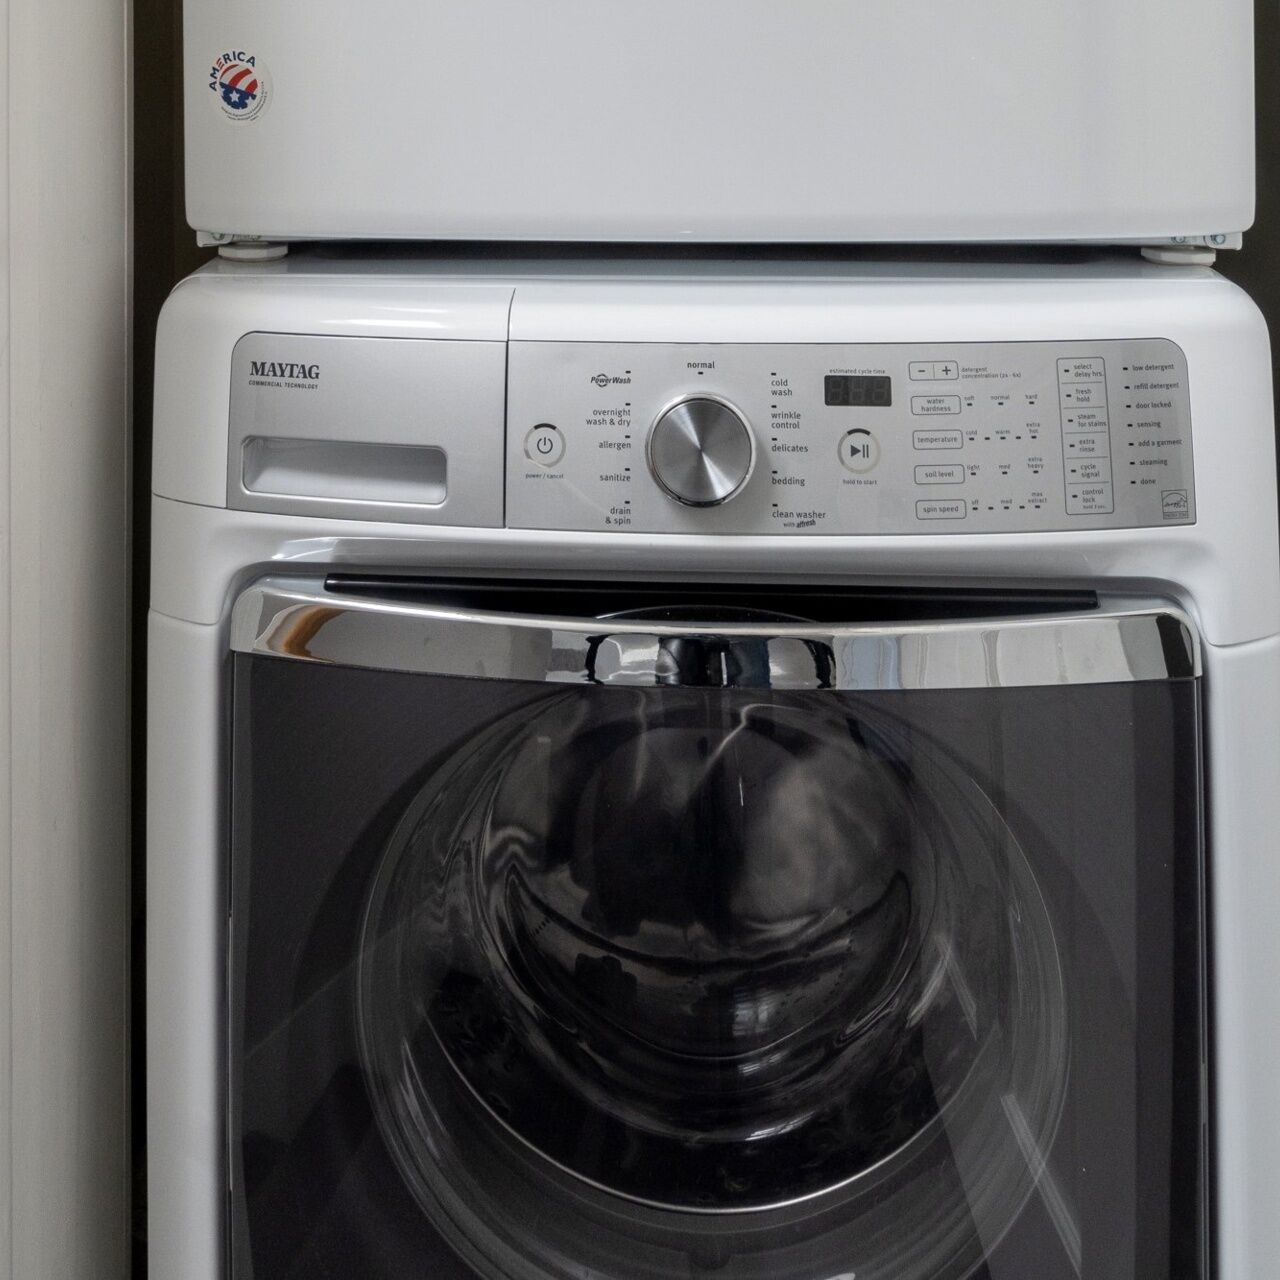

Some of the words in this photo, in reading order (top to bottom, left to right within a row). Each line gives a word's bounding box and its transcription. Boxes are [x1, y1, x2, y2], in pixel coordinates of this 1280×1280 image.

[209, 51, 256, 92] AMERICA
[687, 360, 715, 369] normal
[1144, 363, 1175, 372] detergent
[249, 361, 320, 380] MAYTAG
[248, 380, 282, 388] COMMERCIAL
[284, 382, 319, 390] TECHNOLOGY
[590, 376, 632, 385] PowerWash
[771, 379, 788, 387] cold
[1149, 382, 1179, 391] detergent
[592, 409, 631, 417] overnight
[771, 411, 801, 420] wrinkle
[609, 418, 616, 426] &
[618, 419, 631, 427] dry
[771, 421, 800, 430] control
[1137, 421, 1161, 429] sensing
[917, 436, 958, 444] temperature
[1156, 439, 1183, 448] garment
[598, 441, 631, 450] allergen
[771, 444, 809, 452] delicates
[1139, 458, 1168, 466] steaming
[1080, 463, 1096, 471] cycle
[600, 474, 631, 482] sanitize
[1081, 471, 1100, 479] signal
[772, 477, 805, 486] bedding
[610, 507, 631, 515] drain
[772, 510, 794, 519] clean
[795, 511, 826, 519] washer
[613, 517, 631, 526] spin
